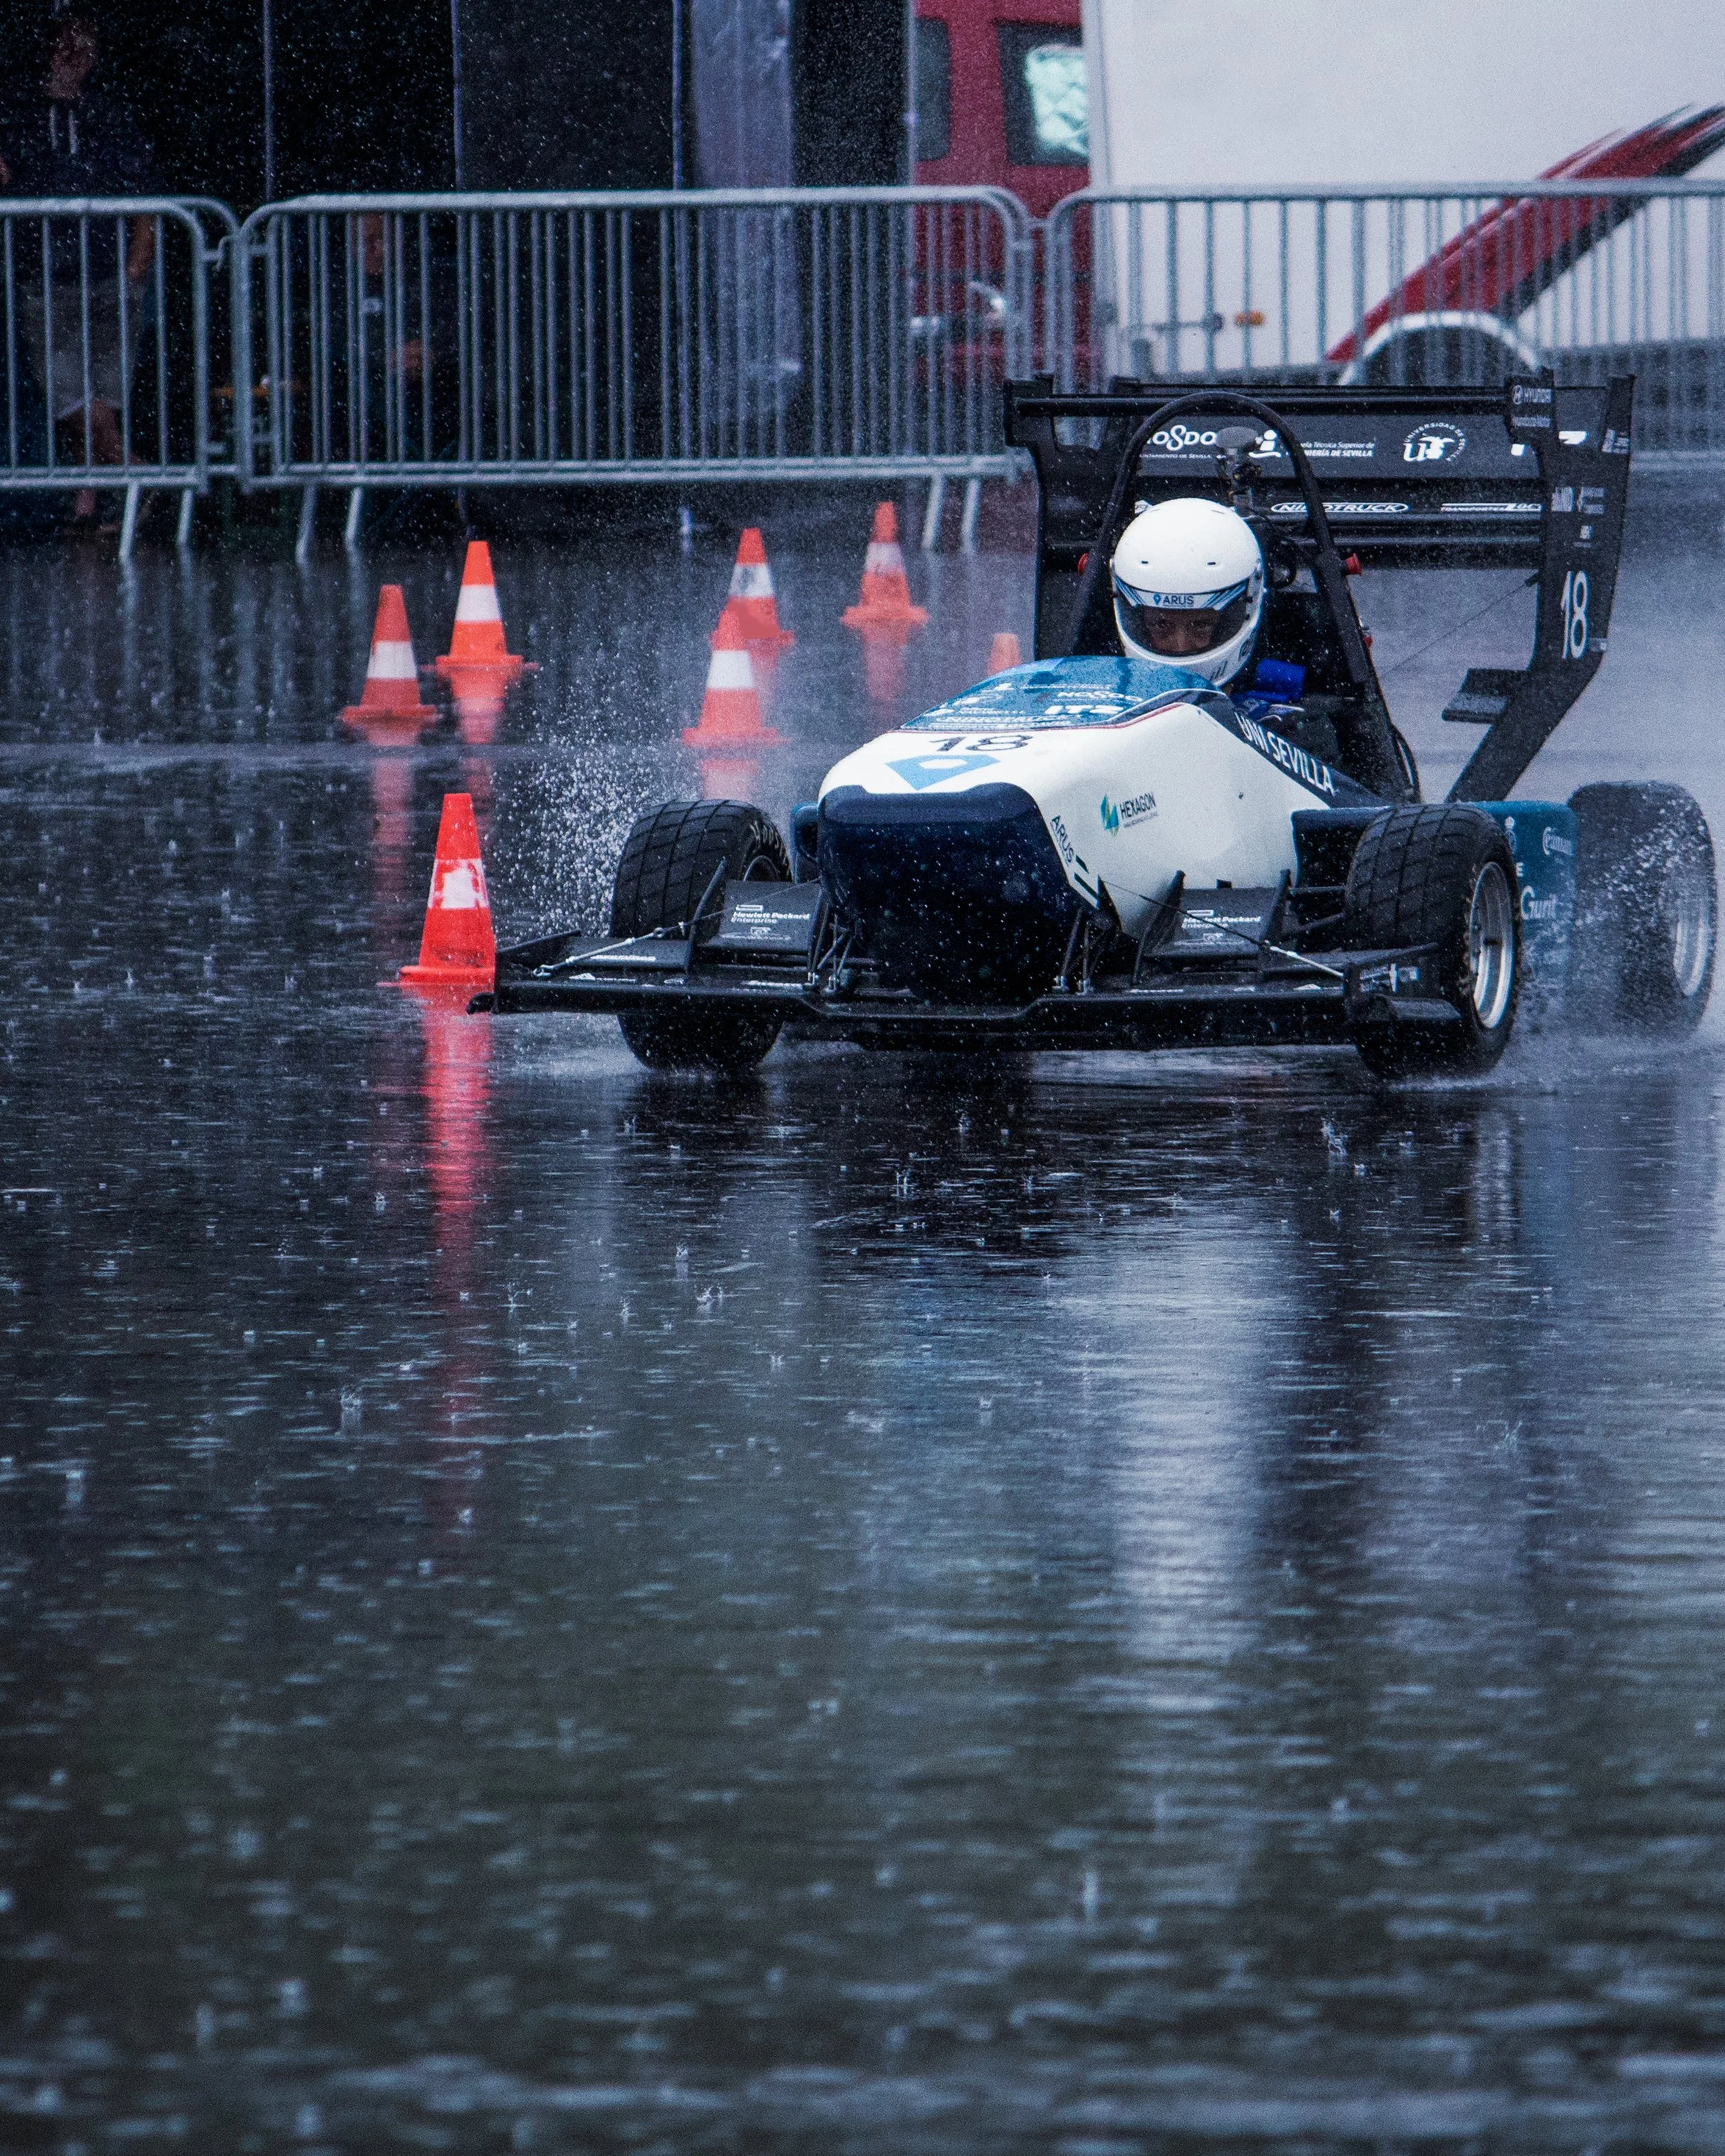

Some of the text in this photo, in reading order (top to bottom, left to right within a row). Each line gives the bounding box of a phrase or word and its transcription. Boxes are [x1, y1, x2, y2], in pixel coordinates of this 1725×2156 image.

[1163, 595, 1194, 605] ARUS
[1560, 570, 1588, 659] 18
[929, 735, 1034, 752] 18
[1234, 711, 1337, 798] UNI SEVILLA
[1119, 791, 1156, 820] HEXAGON
[1051, 814, 1074, 864] ARUS
